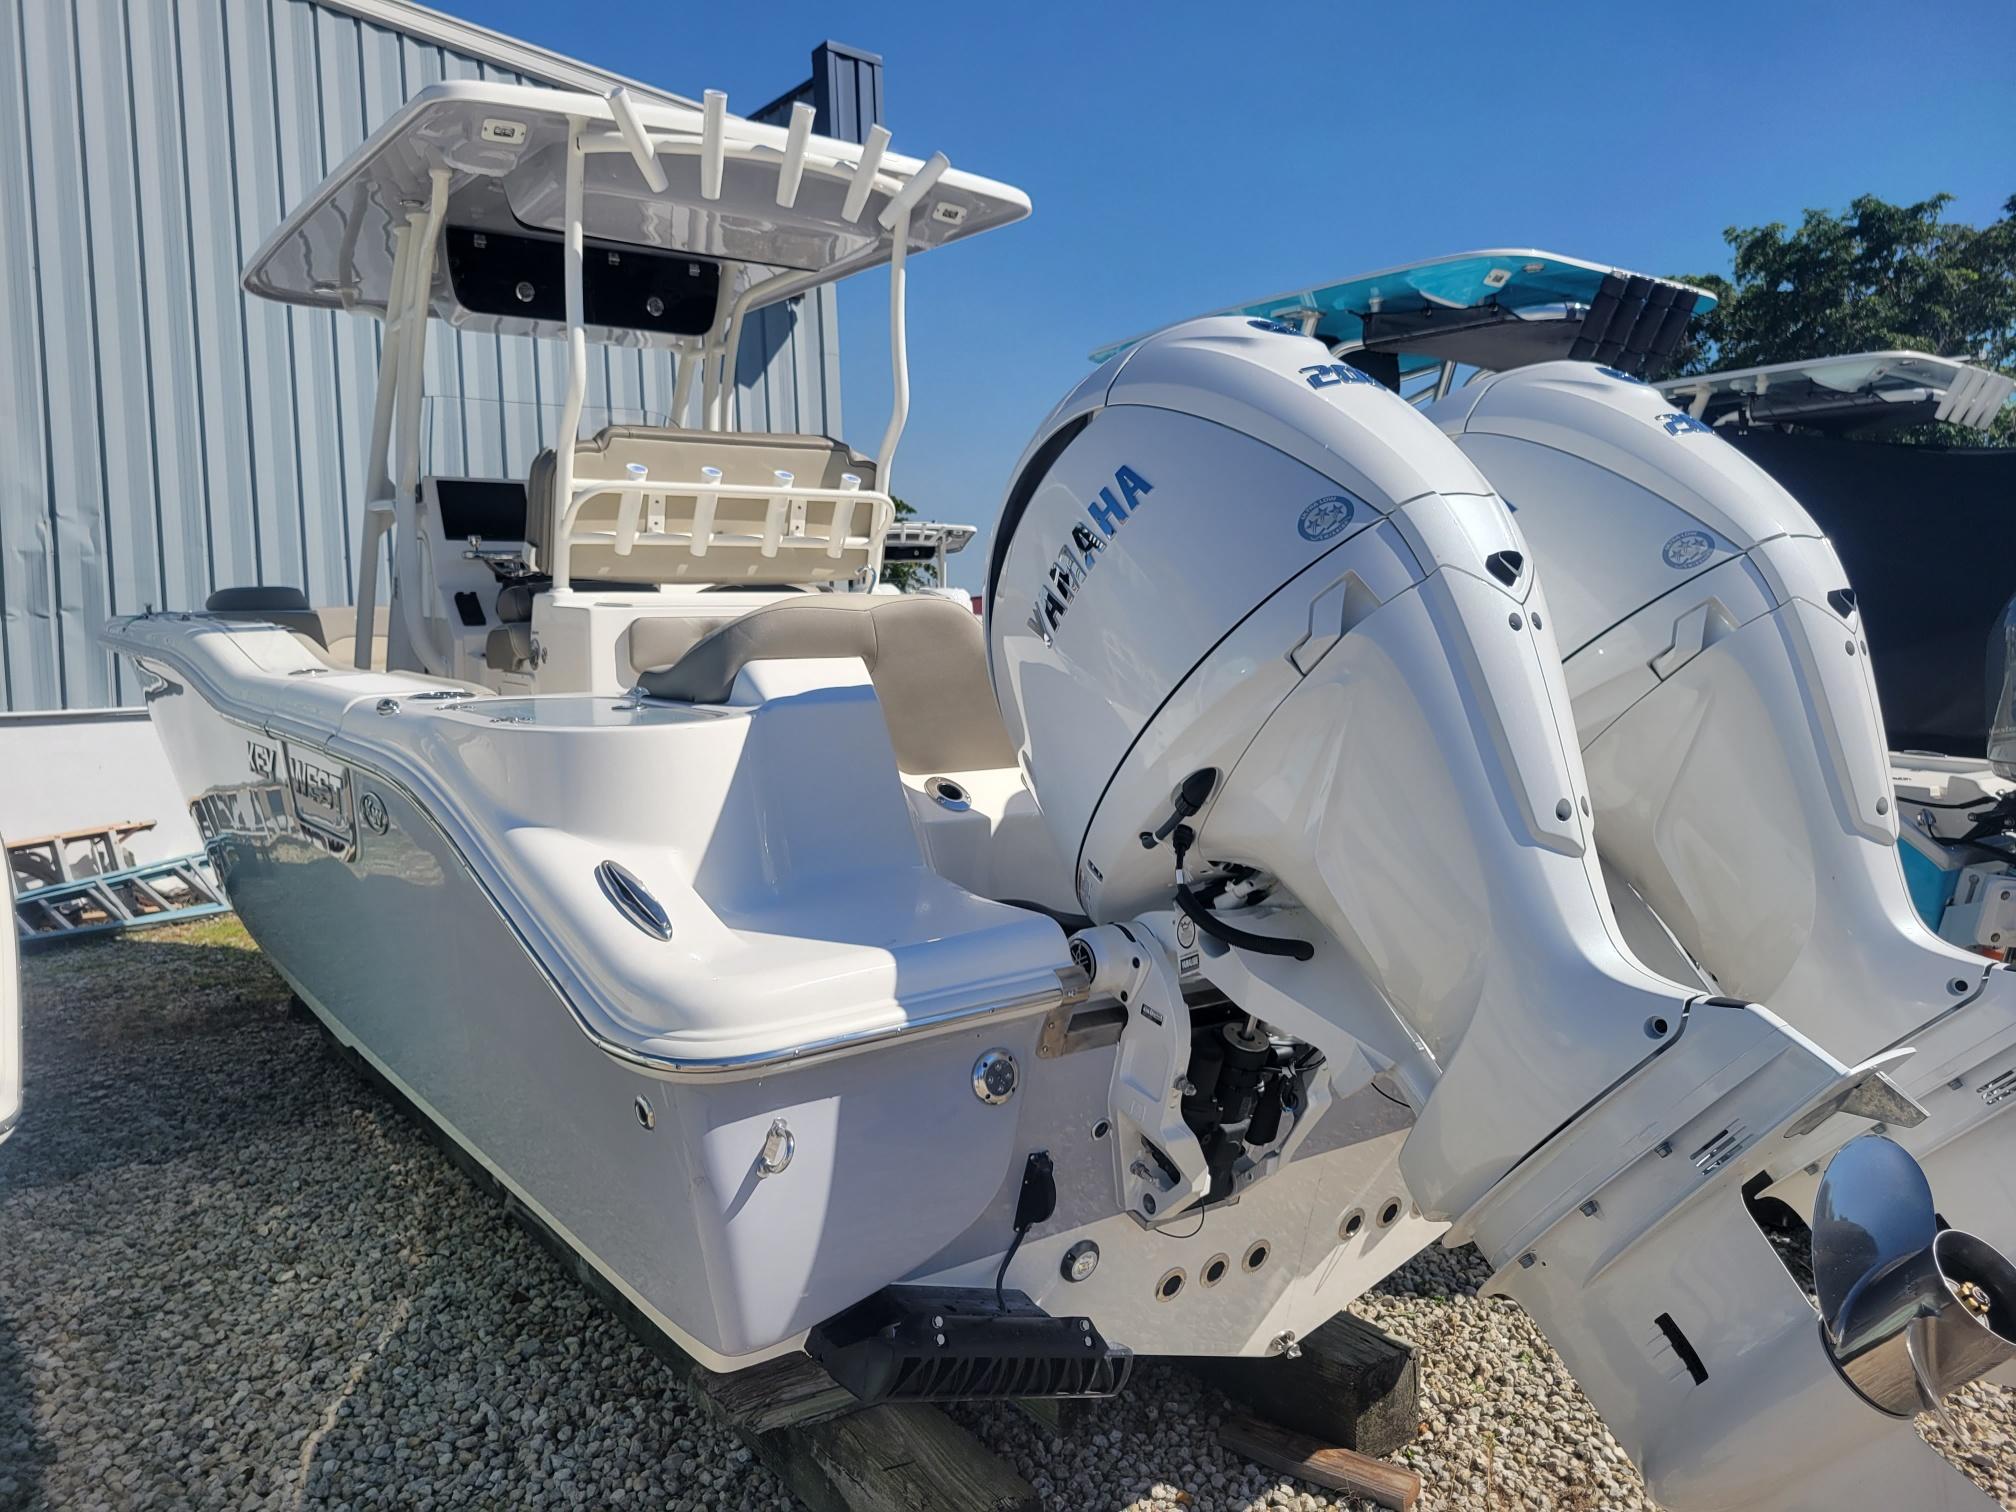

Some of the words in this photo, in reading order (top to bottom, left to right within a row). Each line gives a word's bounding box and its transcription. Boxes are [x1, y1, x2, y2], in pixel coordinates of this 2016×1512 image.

[1027, 464, 1154, 649] YAMAHA
[247, 740, 277, 782] KEY
[289, 757, 345, 815] WEST
